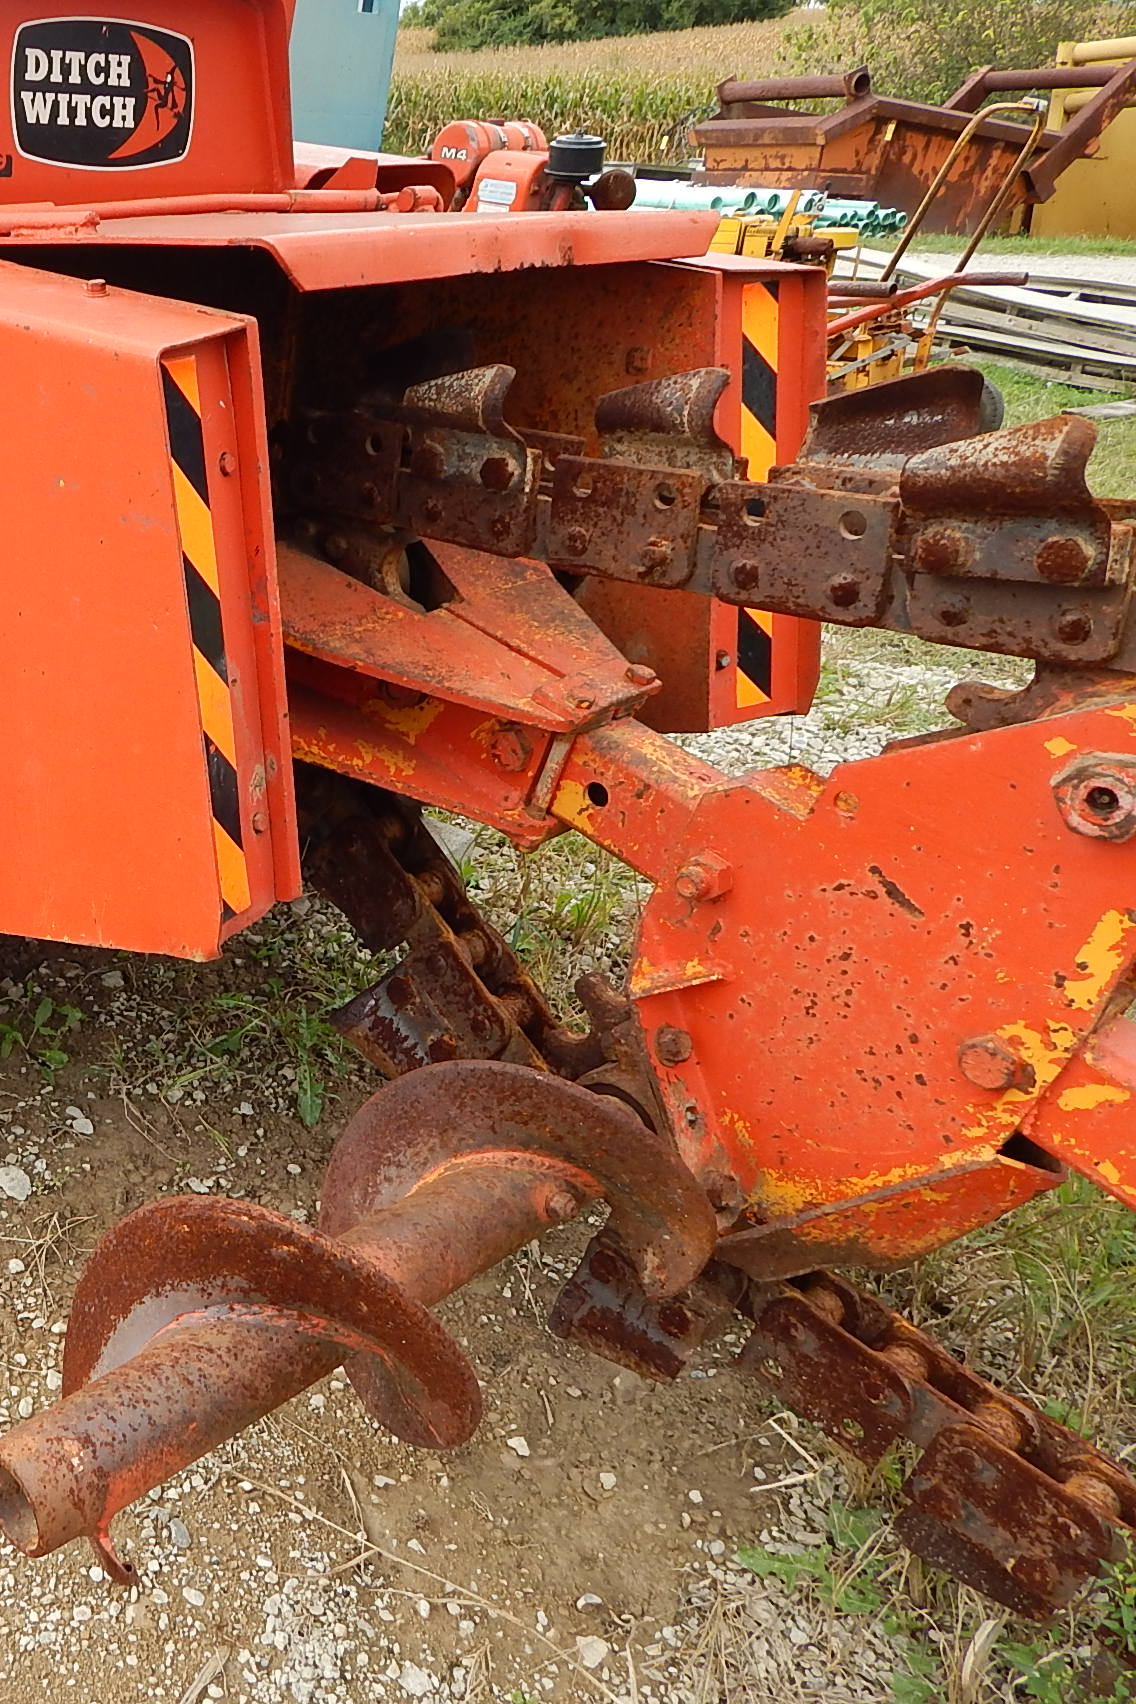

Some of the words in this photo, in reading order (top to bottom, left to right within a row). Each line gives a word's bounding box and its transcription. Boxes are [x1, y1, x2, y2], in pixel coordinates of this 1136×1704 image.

[24, 47, 131, 87] DITCH
[20, 90, 136, 129] WITCH
[441, 145, 467, 160] M4
